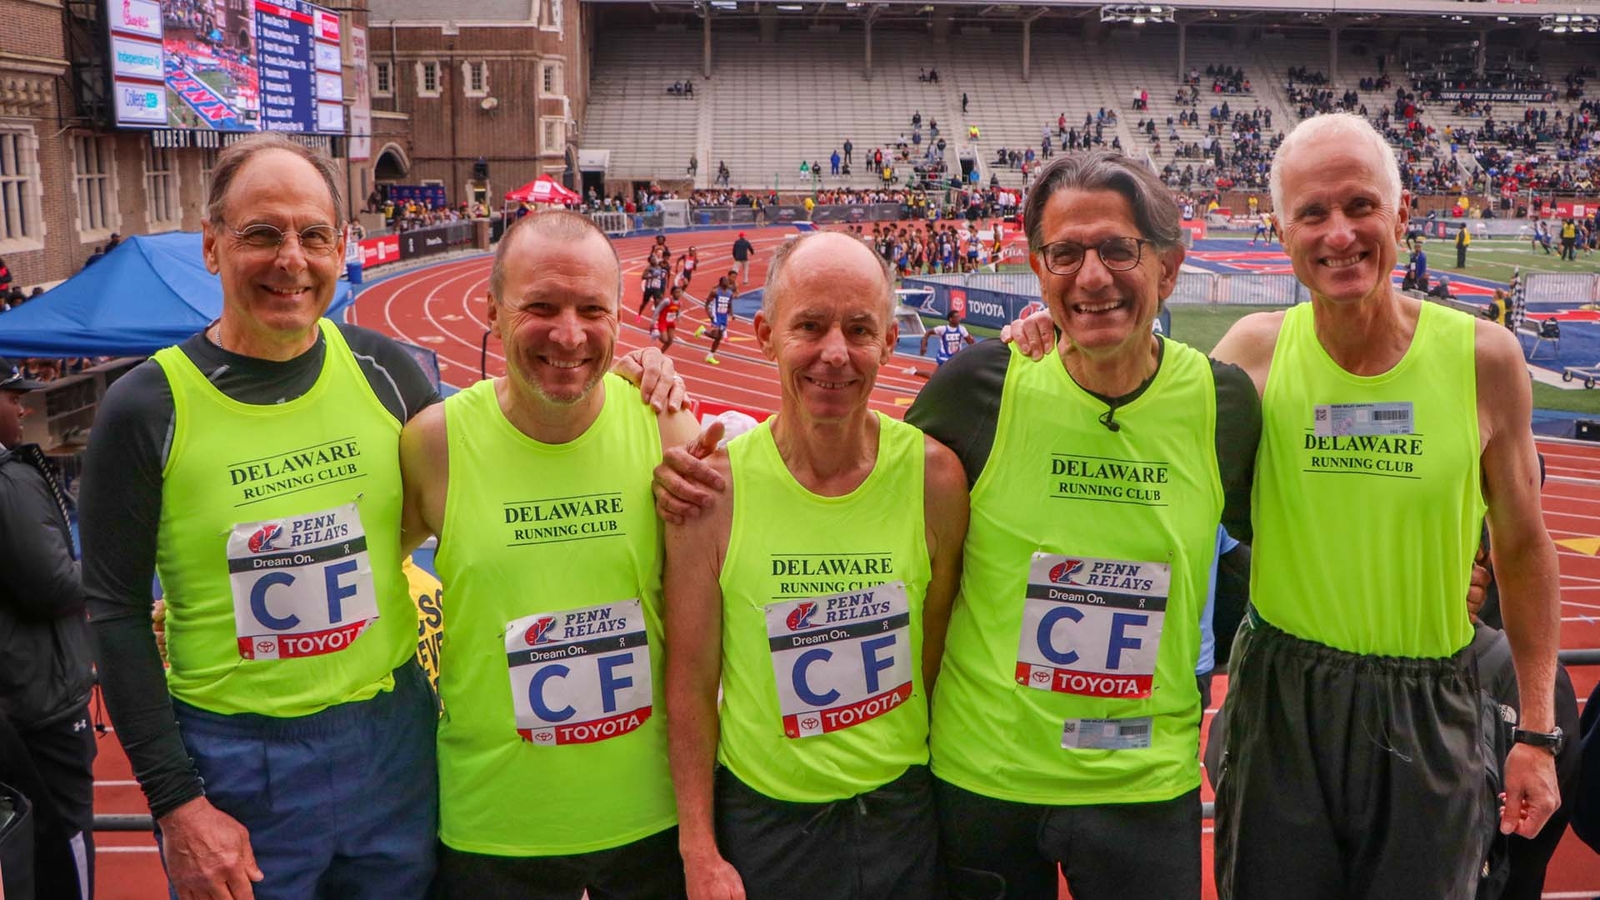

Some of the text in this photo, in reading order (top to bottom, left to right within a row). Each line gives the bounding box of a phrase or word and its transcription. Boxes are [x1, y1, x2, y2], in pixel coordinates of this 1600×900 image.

[1474, 92, 1489, 100] THE
[153, 130, 190, 147] ROBERT
[968, 300, 1006, 318] TOYOTA
[1304, 434, 1423, 456] DELAWARE
[230, 441, 361, 486] DELAWARE
[1051, 459, 1168, 484] DELAWARE
[1311, 456, 1413, 473] RUNNING CLUB
[243, 463, 357, 500] RUNNING CLUB
[1059, 482, 1161, 501] RUNNING CLUB
[504, 498, 623, 524] DELAWARE
[291, 513, 336, 534] PENN
[515, 520, 617, 540] RUNNING CLUB
[290, 524, 349, 547] RELAYS
[253, 554, 314, 568] Dream On.
[771, 558, 893, 576] DELAWARE
[1091, 562, 1141, 577] PENN
[780, 582, 845, 593] RUNNING
[1087, 573, 1153, 591] RELAYS
[250, 571, 301, 631] C
[324, 559, 358, 624] F
[827, 592, 874, 610] PENN
[1049, 589, 1106, 605] Dream On.
[565, 608, 612, 626] PENN
[825, 601, 890, 623] RELAYS
[563, 618, 626, 639] RELAYS
[792, 630, 850, 646] Dream On.
[1037, 606, 1149, 670] C F
[530, 646, 587, 662] Dream On.
[792, 634, 896, 706] C F
[528, 653, 634, 723] C F
[1058, 673, 1139, 695] TOYOTA
[826, 691, 902, 727] TOYOTA
[561, 714, 640, 741] TOYOTA
